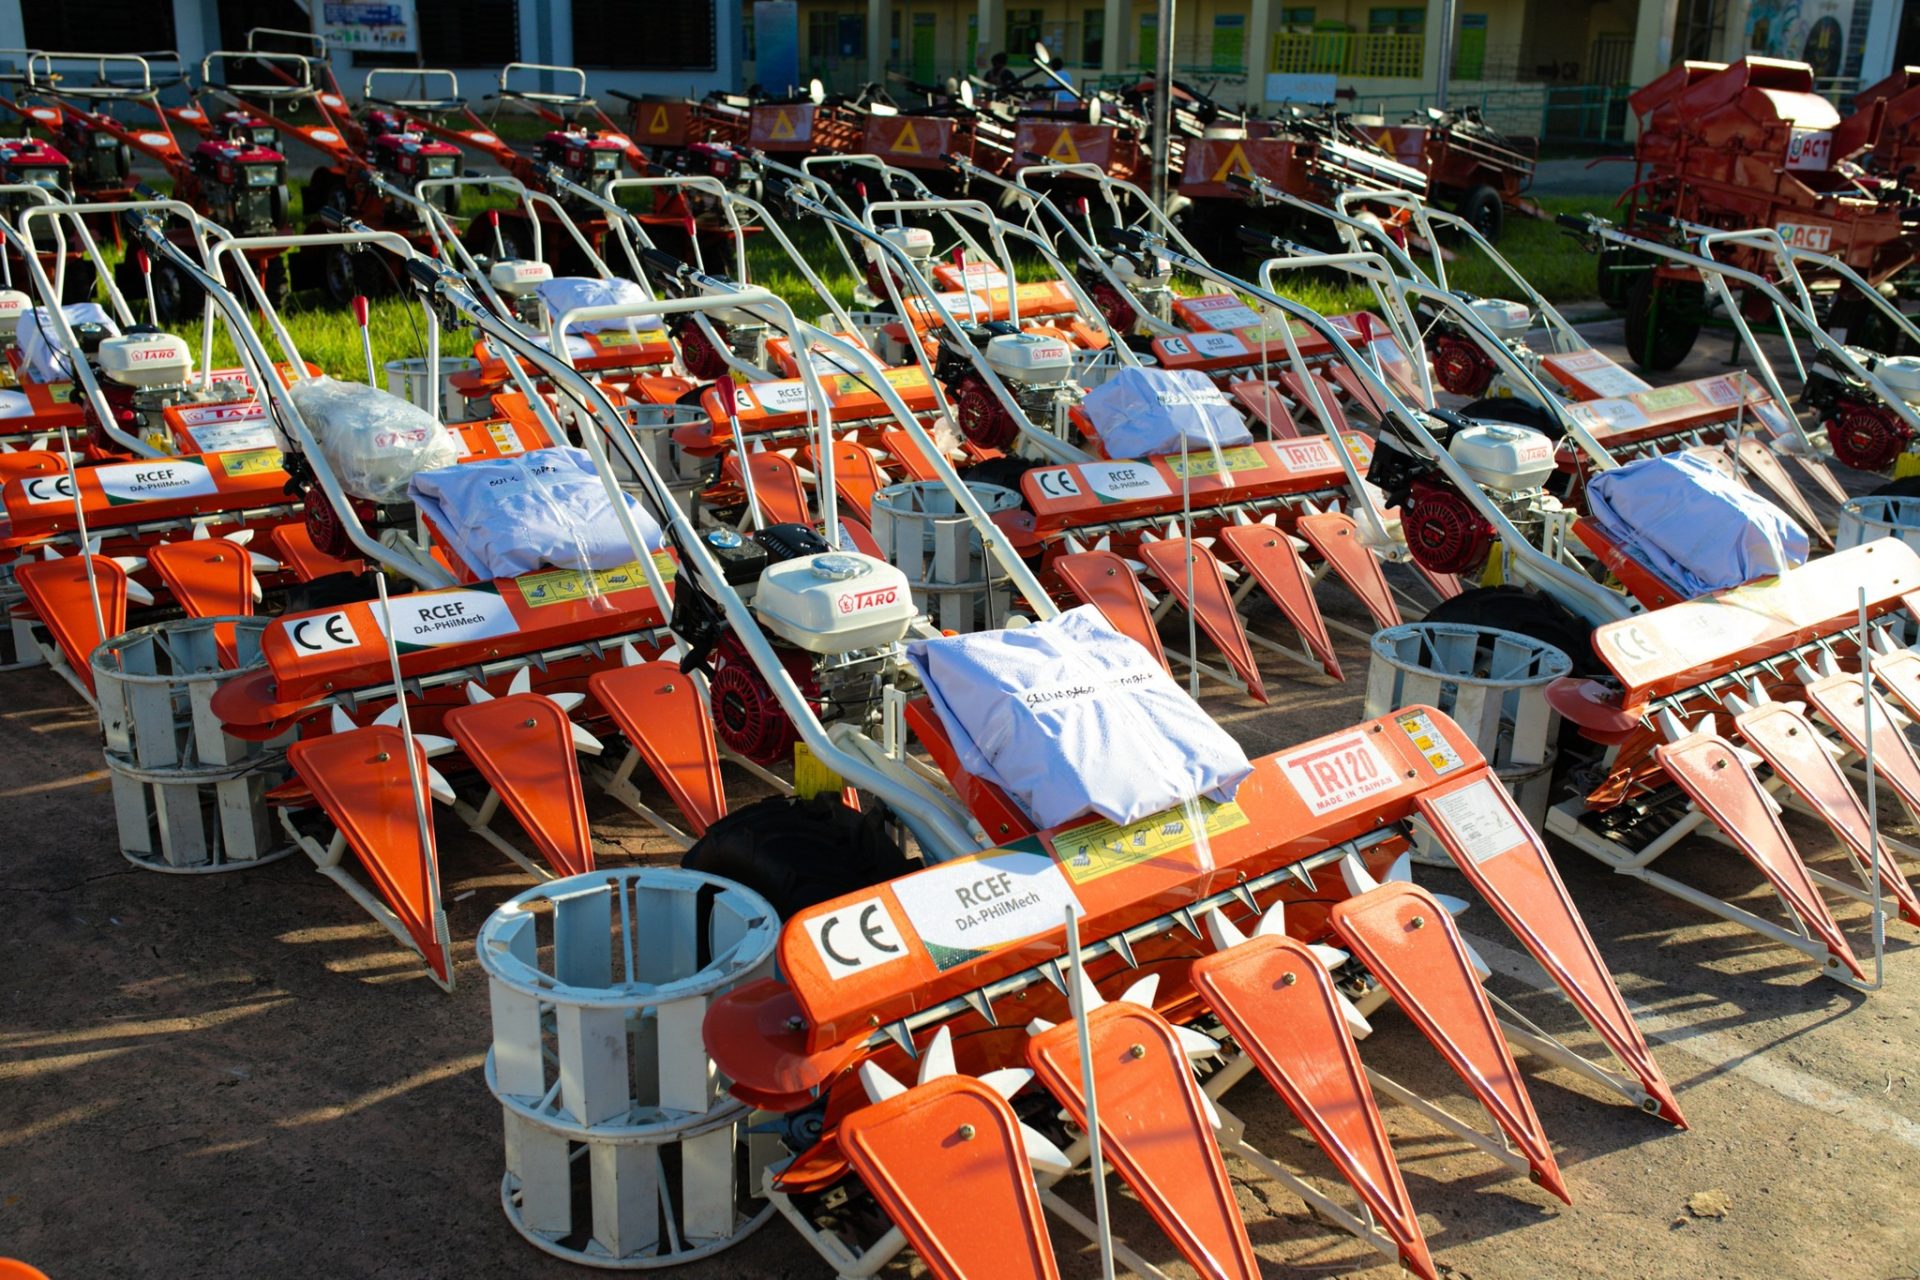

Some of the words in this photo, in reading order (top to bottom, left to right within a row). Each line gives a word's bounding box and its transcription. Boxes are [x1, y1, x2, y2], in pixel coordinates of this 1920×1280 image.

[1802, 139, 1830, 158] ACT
[1792, 226, 1830, 248] ACT
[143, 348, 177, 360] TARO
[1041, 348, 1064, 359] TARO
[1163, 338, 1189, 354] CE
[778, 387, 804, 398] RCEF
[1276, 441, 1329, 466] TR120
[1525, 446, 1548, 460] TARO
[135, 468, 176, 484] RCEF
[1040, 470, 1078, 496] CE
[1108, 469, 1138, 482] RCEF
[28, 476, 75, 500] CE
[853, 586, 898, 610] TARO
[417, 601, 466, 623] RCEF
[293, 614, 354, 651] CE
[413, 613, 486, 635] DA-PHilMech
[1613, 627, 1657, 660] CE
[1287, 737, 1380, 799] TR120
[1315, 794, 1344, 810] MADE
[1345, 789, 1357, 800] IN
[1358, 775, 1393, 795] TAIWAN
[954, 872, 1015, 910] RCEF
[955, 891, 1041, 932] DA-PHilMech
[820, 903, 900, 967] CE
